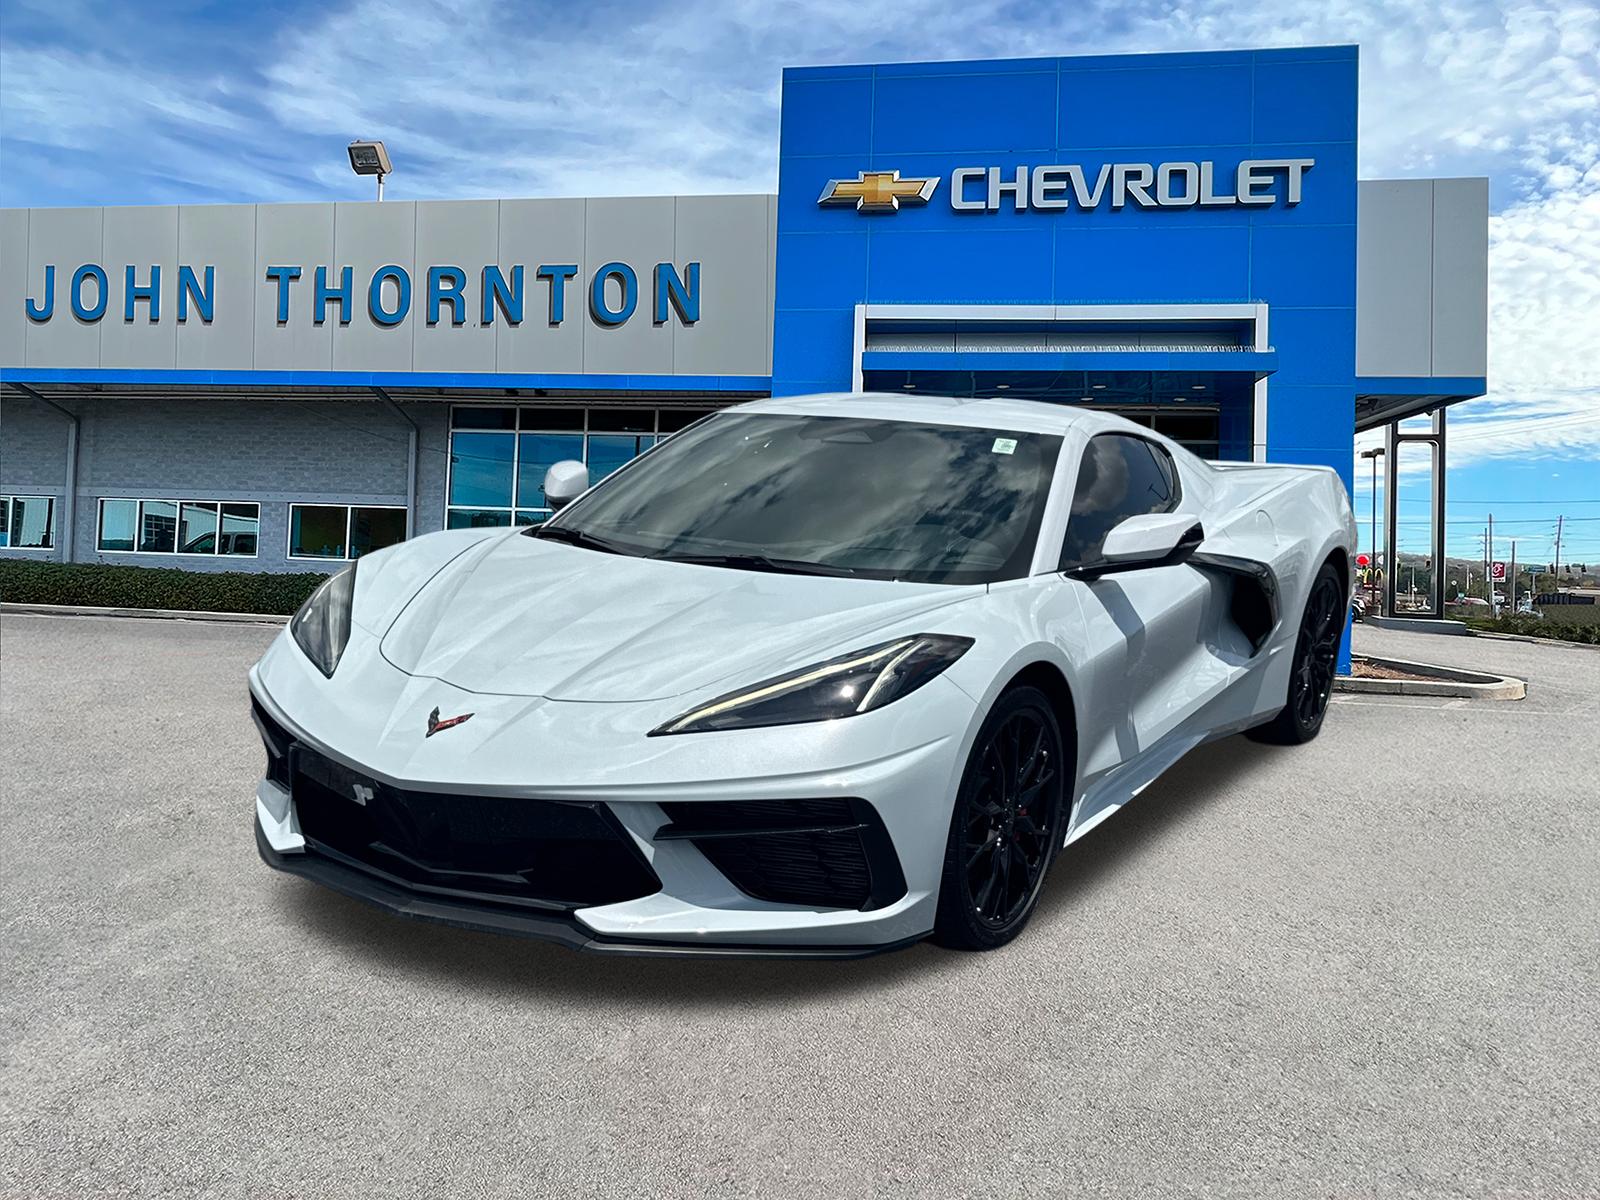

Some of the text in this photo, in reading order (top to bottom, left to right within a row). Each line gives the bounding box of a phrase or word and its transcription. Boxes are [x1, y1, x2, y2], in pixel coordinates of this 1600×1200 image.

[951, 158, 1315, 211] CHEVROLET
[25, 262, 701, 327] JOHN THORNTON
